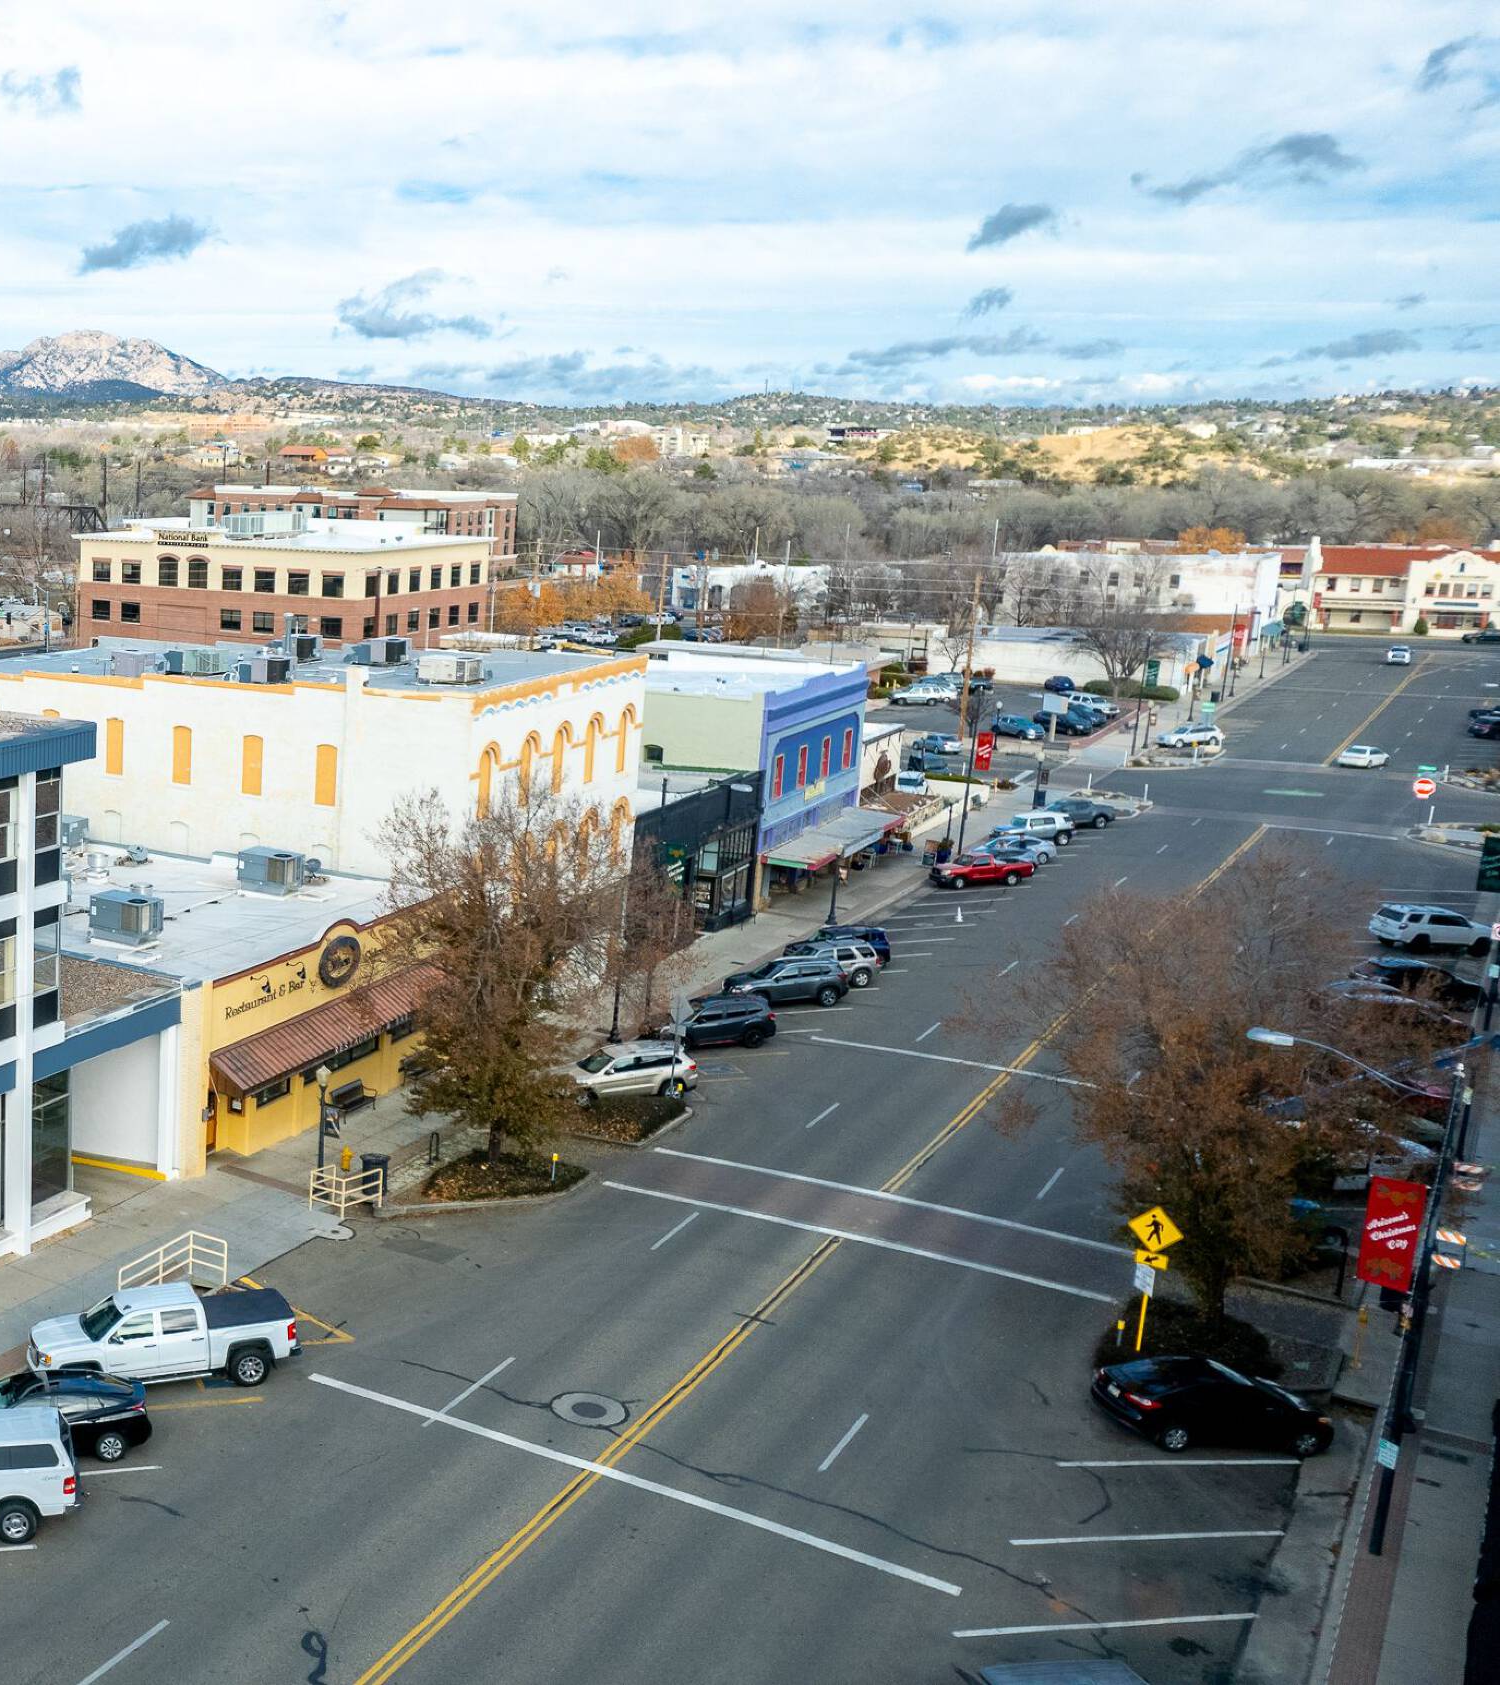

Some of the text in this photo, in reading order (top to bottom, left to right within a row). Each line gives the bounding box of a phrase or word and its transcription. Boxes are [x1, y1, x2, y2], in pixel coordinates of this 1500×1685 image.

[158, 533, 208, 542] National Bank
[224, 979, 305, 1020] Restaurant & Bar
[1366, 1211, 1409, 1230] Arizona's
[1370, 1224, 1417, 1241] Christmas
[1386, 1239, 1409, 1250] City
